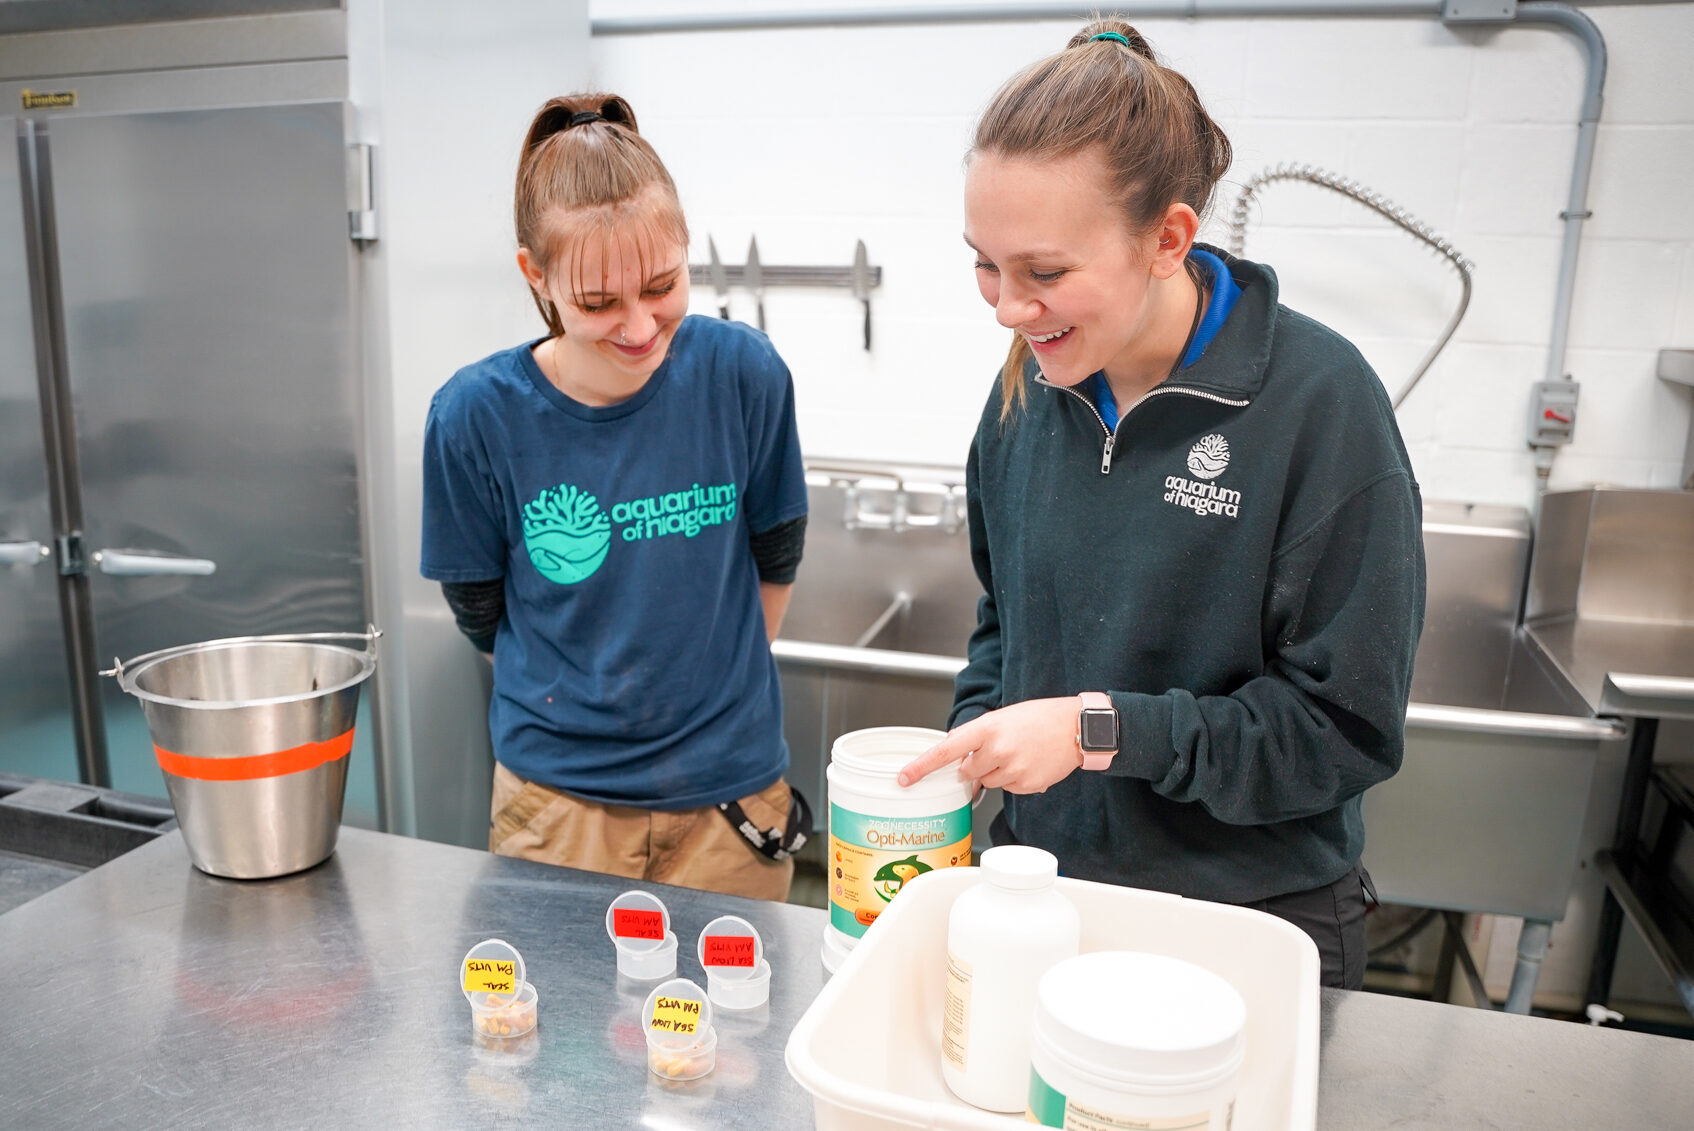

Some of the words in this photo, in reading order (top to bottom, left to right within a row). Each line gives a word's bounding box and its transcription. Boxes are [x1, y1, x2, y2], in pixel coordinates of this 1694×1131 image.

[1165, 476, 1241, 504] aquarium
[611, 483, 736, 523] aquarium
[1164, 490, 1176, 503] of
[1174, 490, 1239, 518] niagara
[622, 520, 643, 541] of
[645, 501, 736, 538] niagara
[867, 829, 946, 847] Opti-Marine
[468, 962, 492, 972] VITS
[496, 963, 513, 976] PM
[482, 982, 510, 991] SEAL
[657, 997, 681, 1009] VITS
[683, 1002, 699, 1014] PM
[651, 1018, 671, 1029] LION
[673, 1019, 694, 1032] SEA
